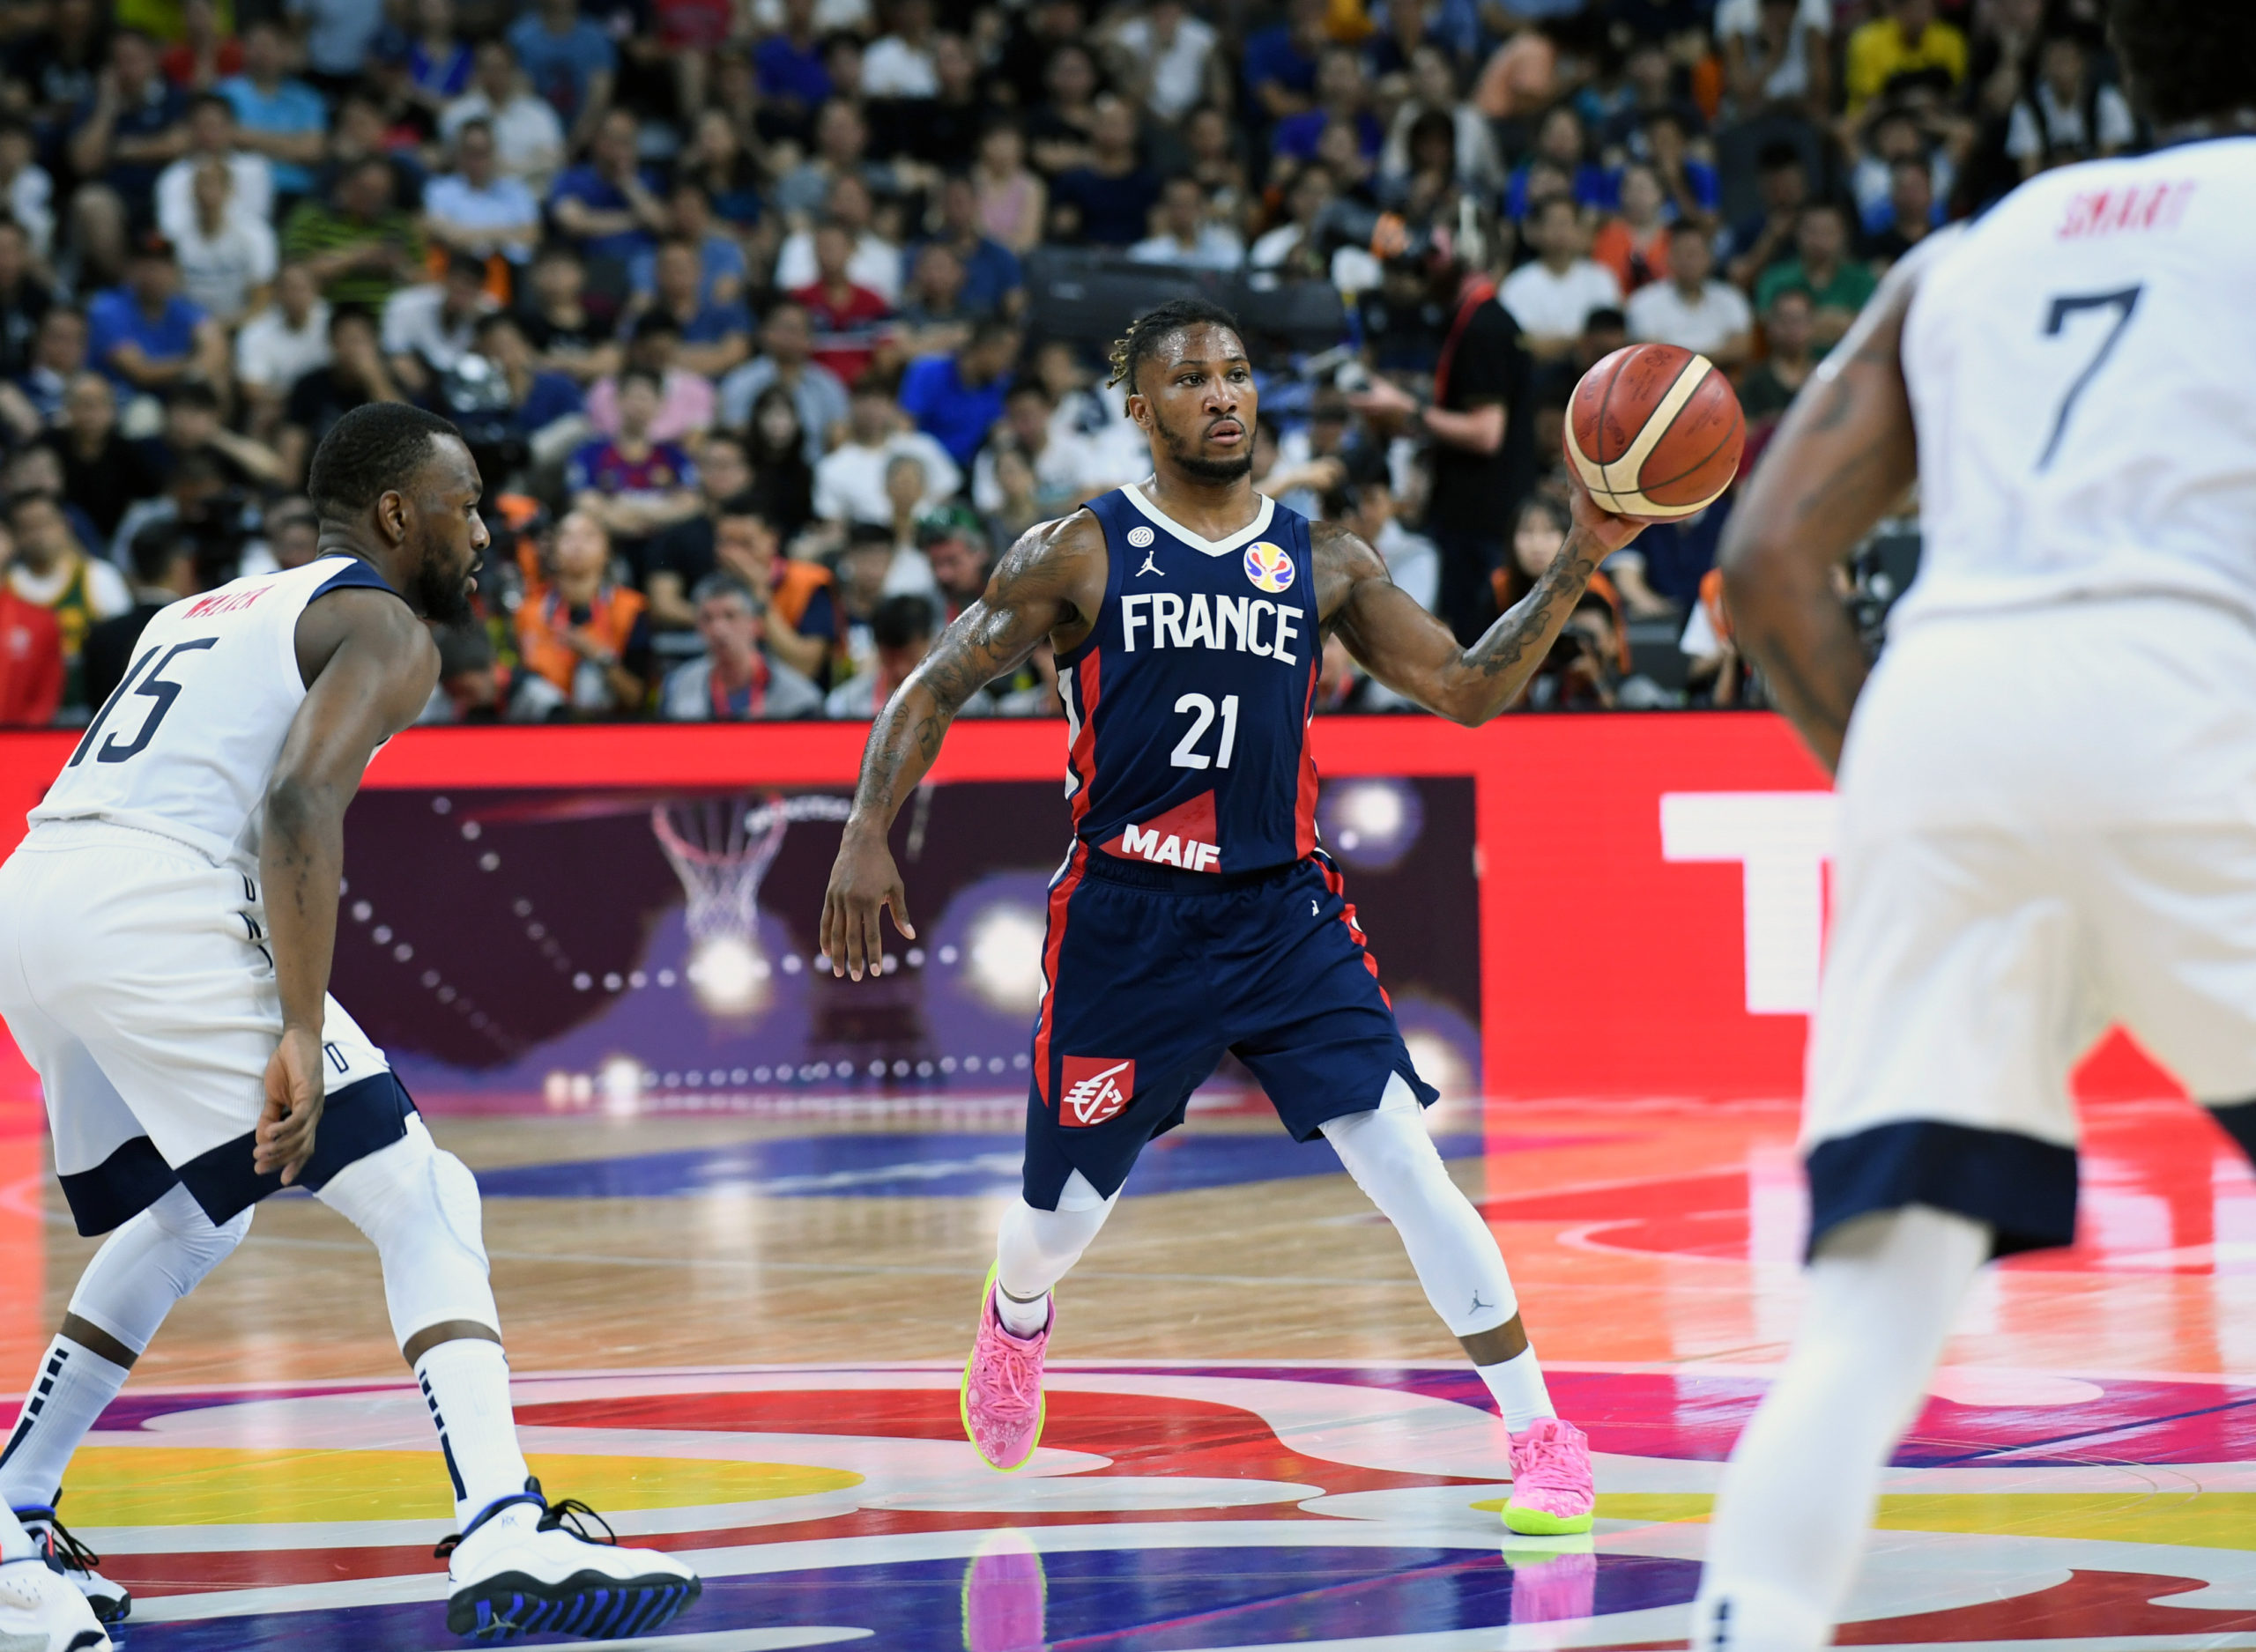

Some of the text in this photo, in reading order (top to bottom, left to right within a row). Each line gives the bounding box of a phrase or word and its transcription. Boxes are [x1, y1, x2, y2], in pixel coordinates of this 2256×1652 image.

[2036, 280, 2145, 472] 7
[1121, 592, 1304, 666] FRANCE
[68, 636, 220, 767] 15
[1170, 693, 1239, 769] 21
[1122, 824, 1221, 872] MAIF
